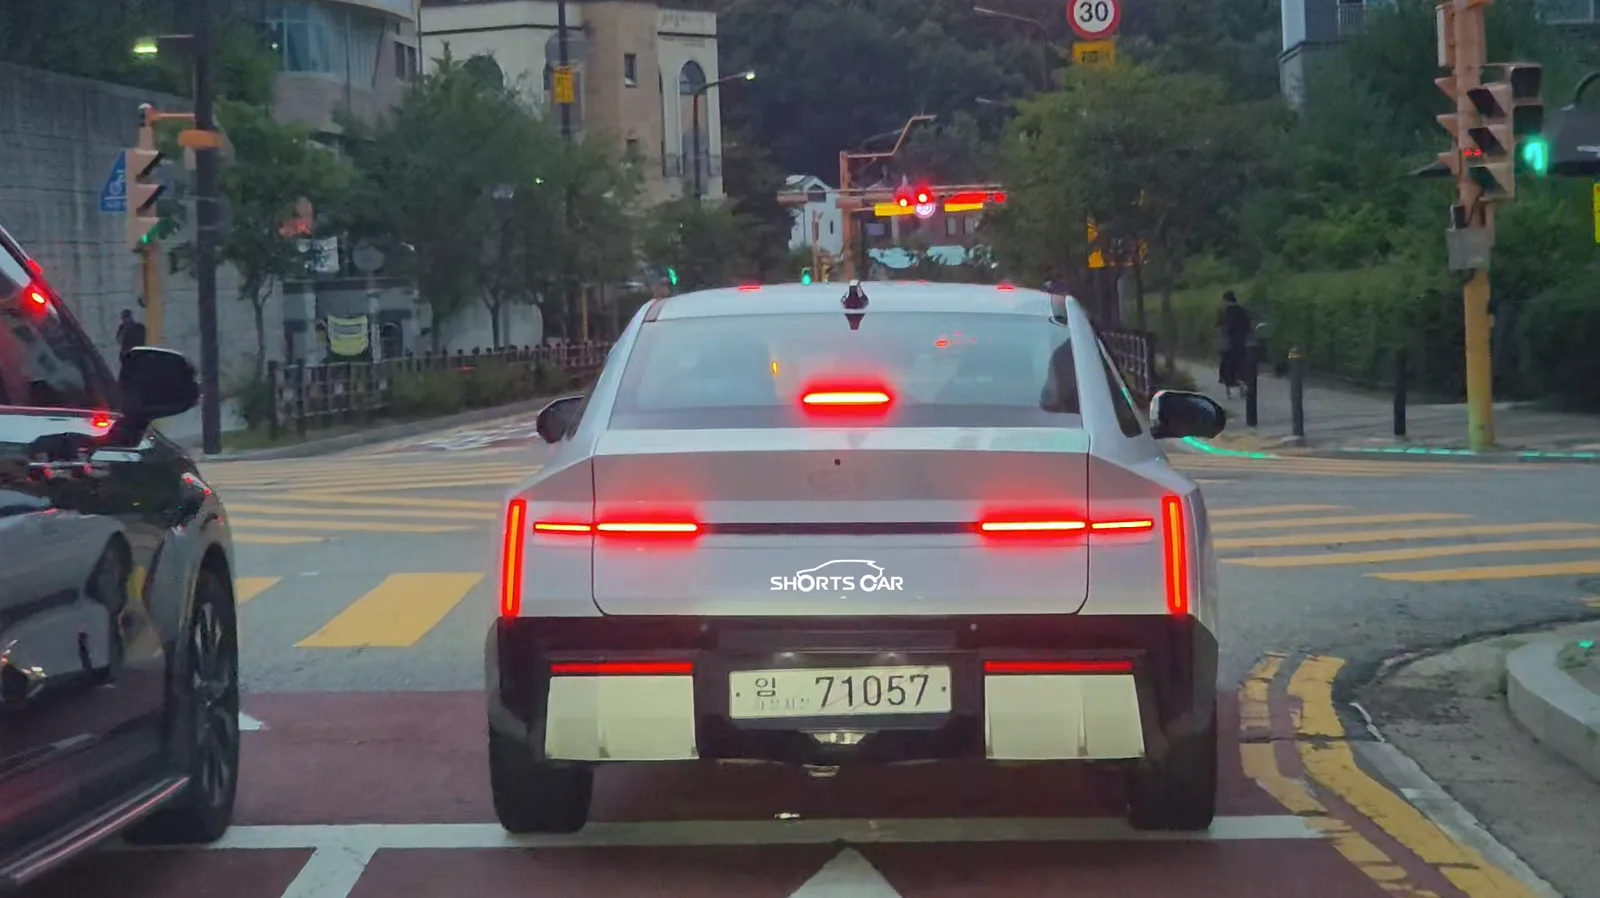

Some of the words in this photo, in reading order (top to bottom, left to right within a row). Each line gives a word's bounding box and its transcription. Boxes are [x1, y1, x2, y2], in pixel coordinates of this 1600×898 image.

[1080, 1, 1109, 22] 30
[755, 677, 776, 697] 임
[815, 674, 930, 708] 71057
